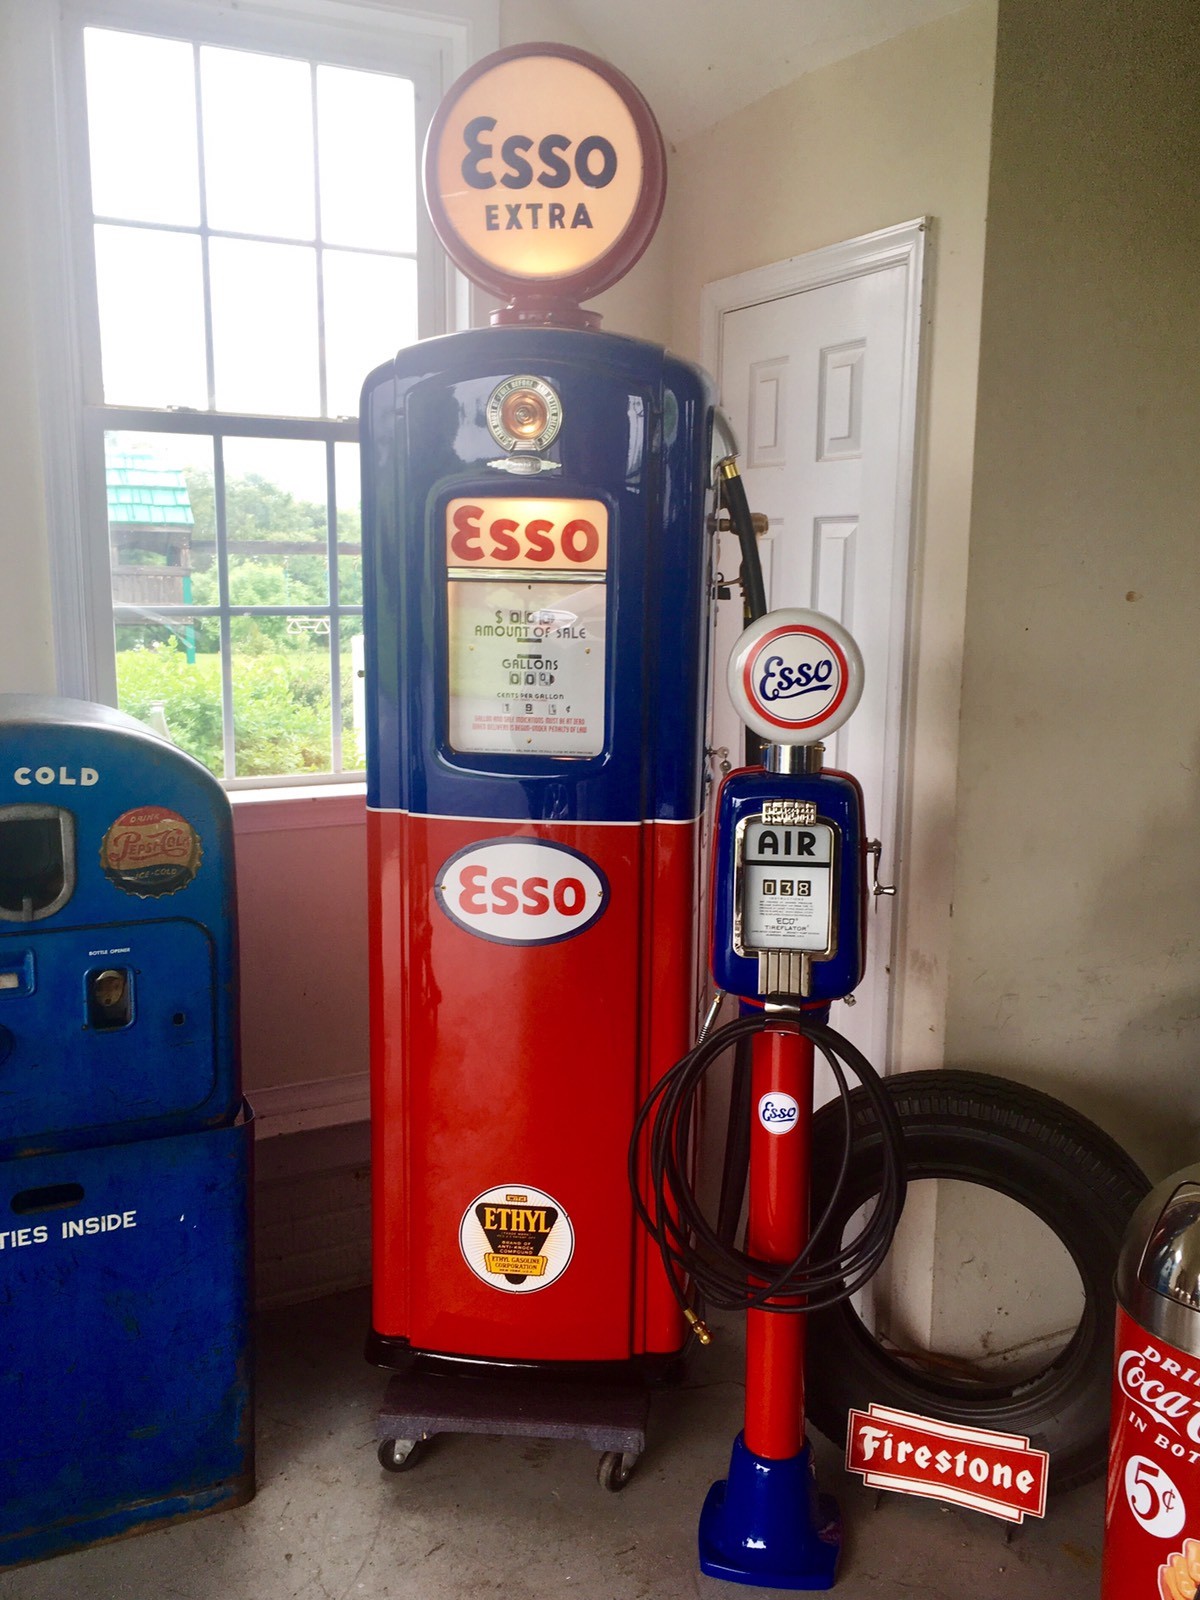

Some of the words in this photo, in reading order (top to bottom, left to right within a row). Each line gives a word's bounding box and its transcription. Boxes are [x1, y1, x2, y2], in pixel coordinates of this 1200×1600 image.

[461, 116, 617, 190] ESSO
[485, 202, 594, 231] EXTRA
[451, 505, 599, 563] ESSO
[475, 625, 530, 637] AMOUNT
[533, 627, 551, 637] OF
[557, 627, 586, 639] SALE
[502, 659, 559, 670] GALLONS
[759, 656, 833, 701] Esso
[14, 766, 99, 786] COLD
[758, 830, 816, 856] AIR
[458, 865, 586, 916] ESSO
[762, 1101, 796, 1122] Esso
[0, 1226, 48, 1250] TIES
[62, 1210, 137, 1239] INSIDE
[484, 1207, 550, 1233] ETHYL
[1128, 1411, 1148, 1433] IN
[858, 1425, 1035, 1494] Firestone
